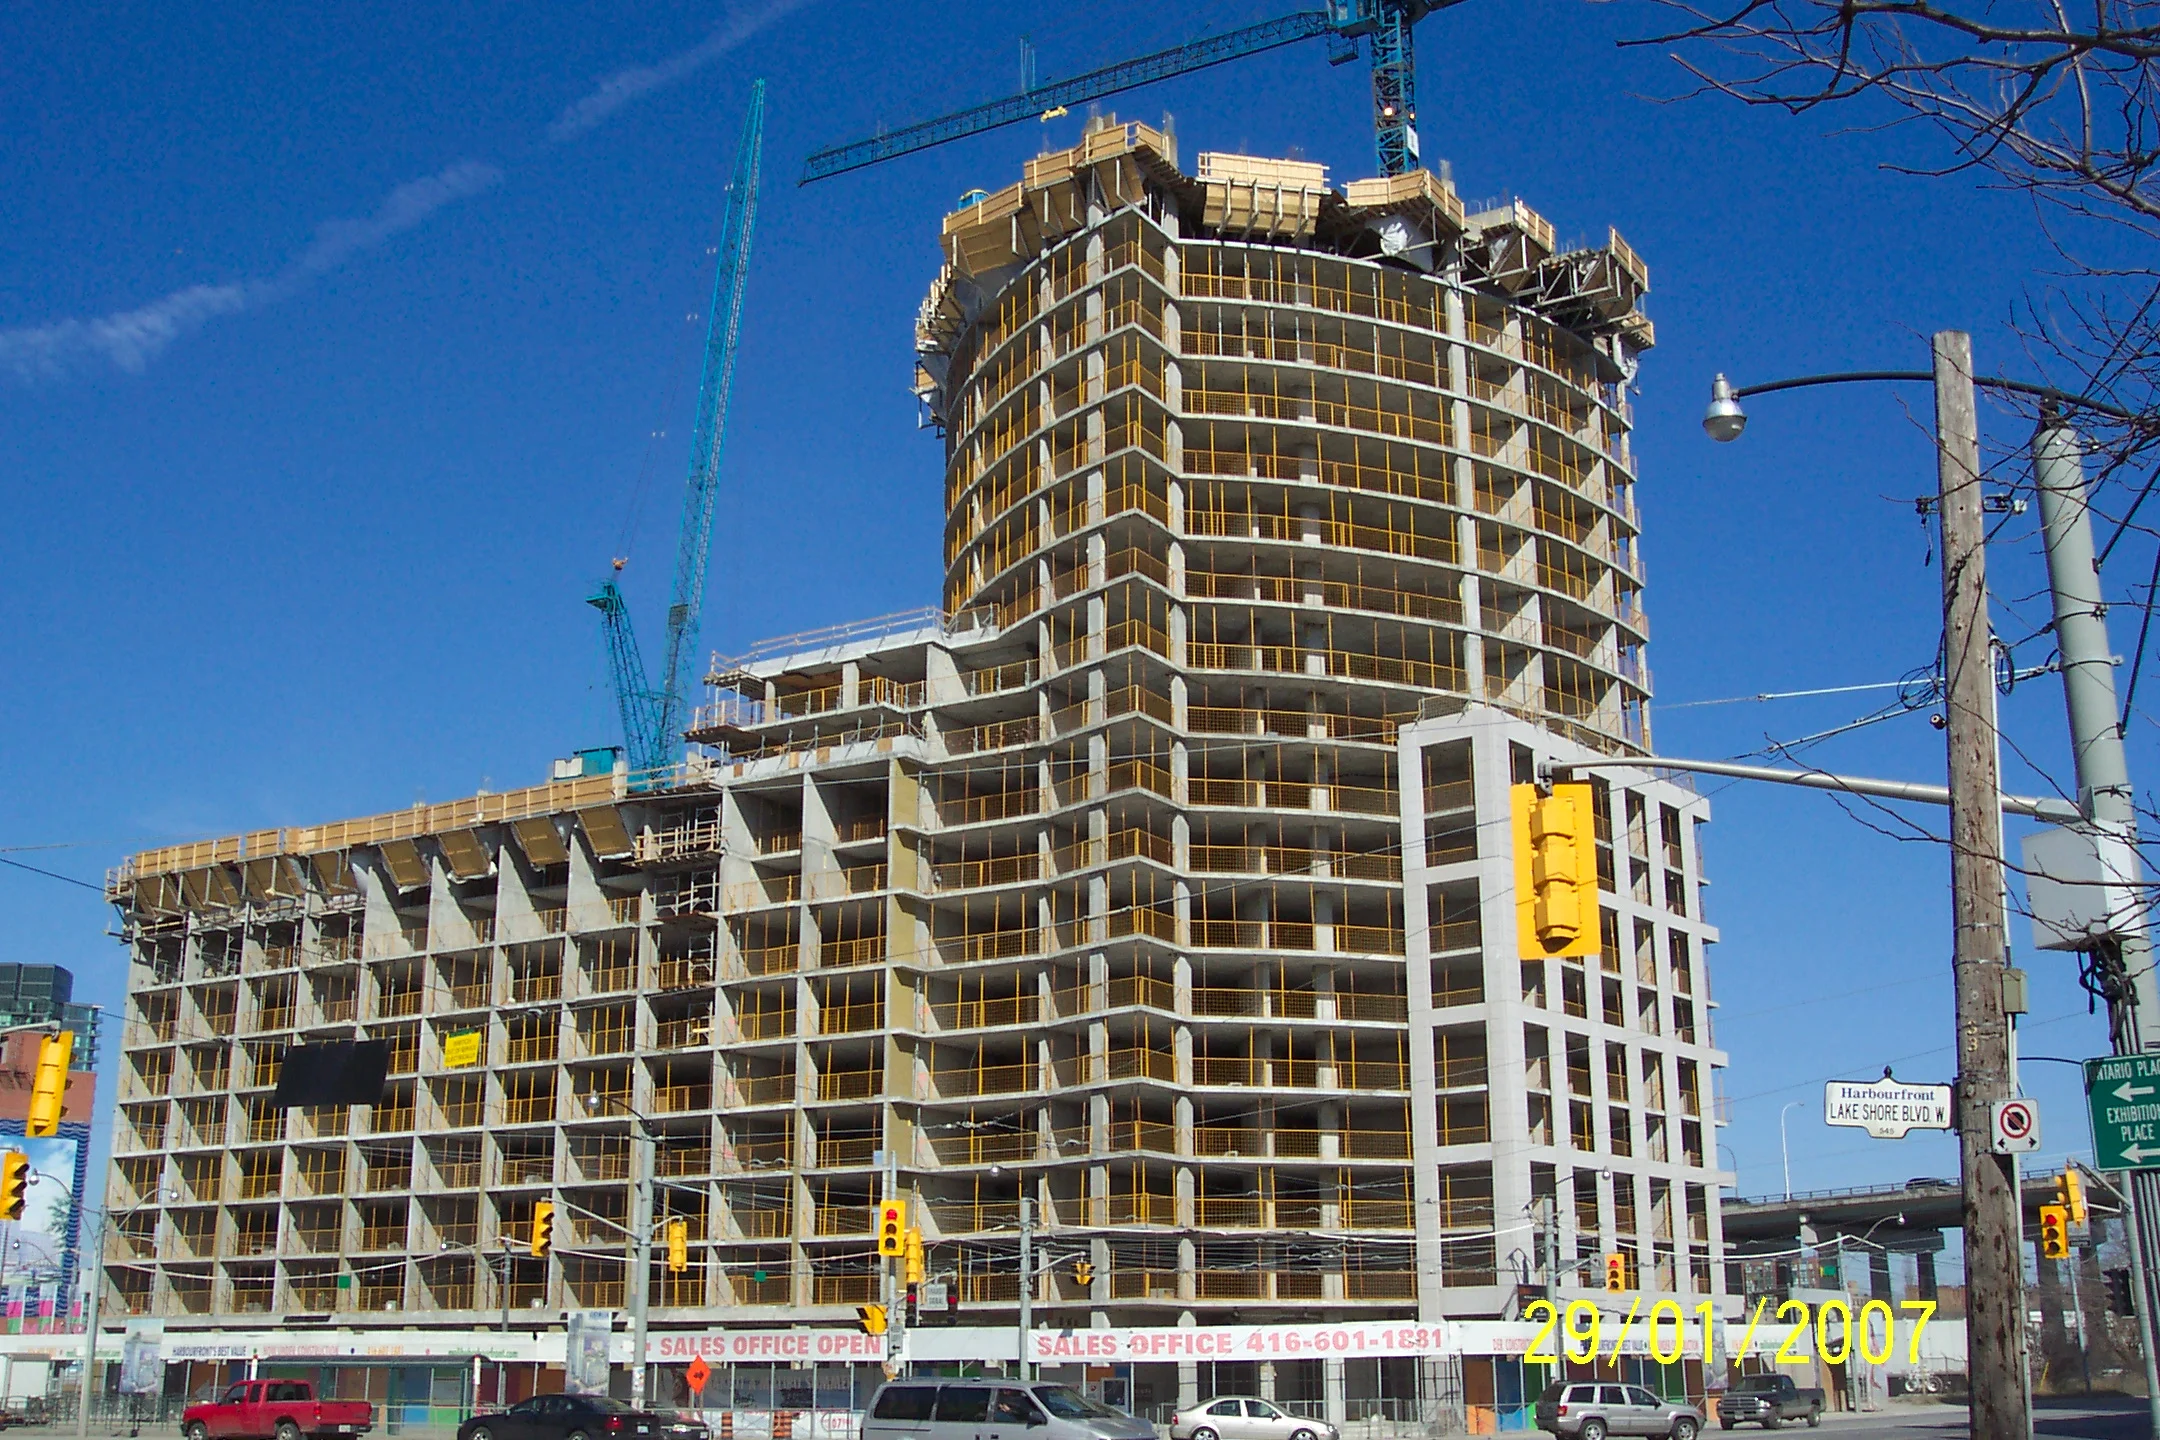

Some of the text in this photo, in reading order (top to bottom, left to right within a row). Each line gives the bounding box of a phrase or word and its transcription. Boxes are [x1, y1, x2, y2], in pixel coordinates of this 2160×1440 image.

[2094, 1062, 2132, 1080] NTARIO
[1841, 1087, 1935, 1101] Harbourfront
[1830, 1103, 1859, 1120] LAKE
[1862, 1103, 1899, 1121] SHORE
[2120, 1123, 2155, 1142] PLACE
[660, 1336, 725, 1356] SALES
[733, 1335, 809, 1355] OFFICE
[817, 1333, 881, 1354] OPEN
[1037, 1328, 1441, 1356] SALES OFFICE 416-601-1881
